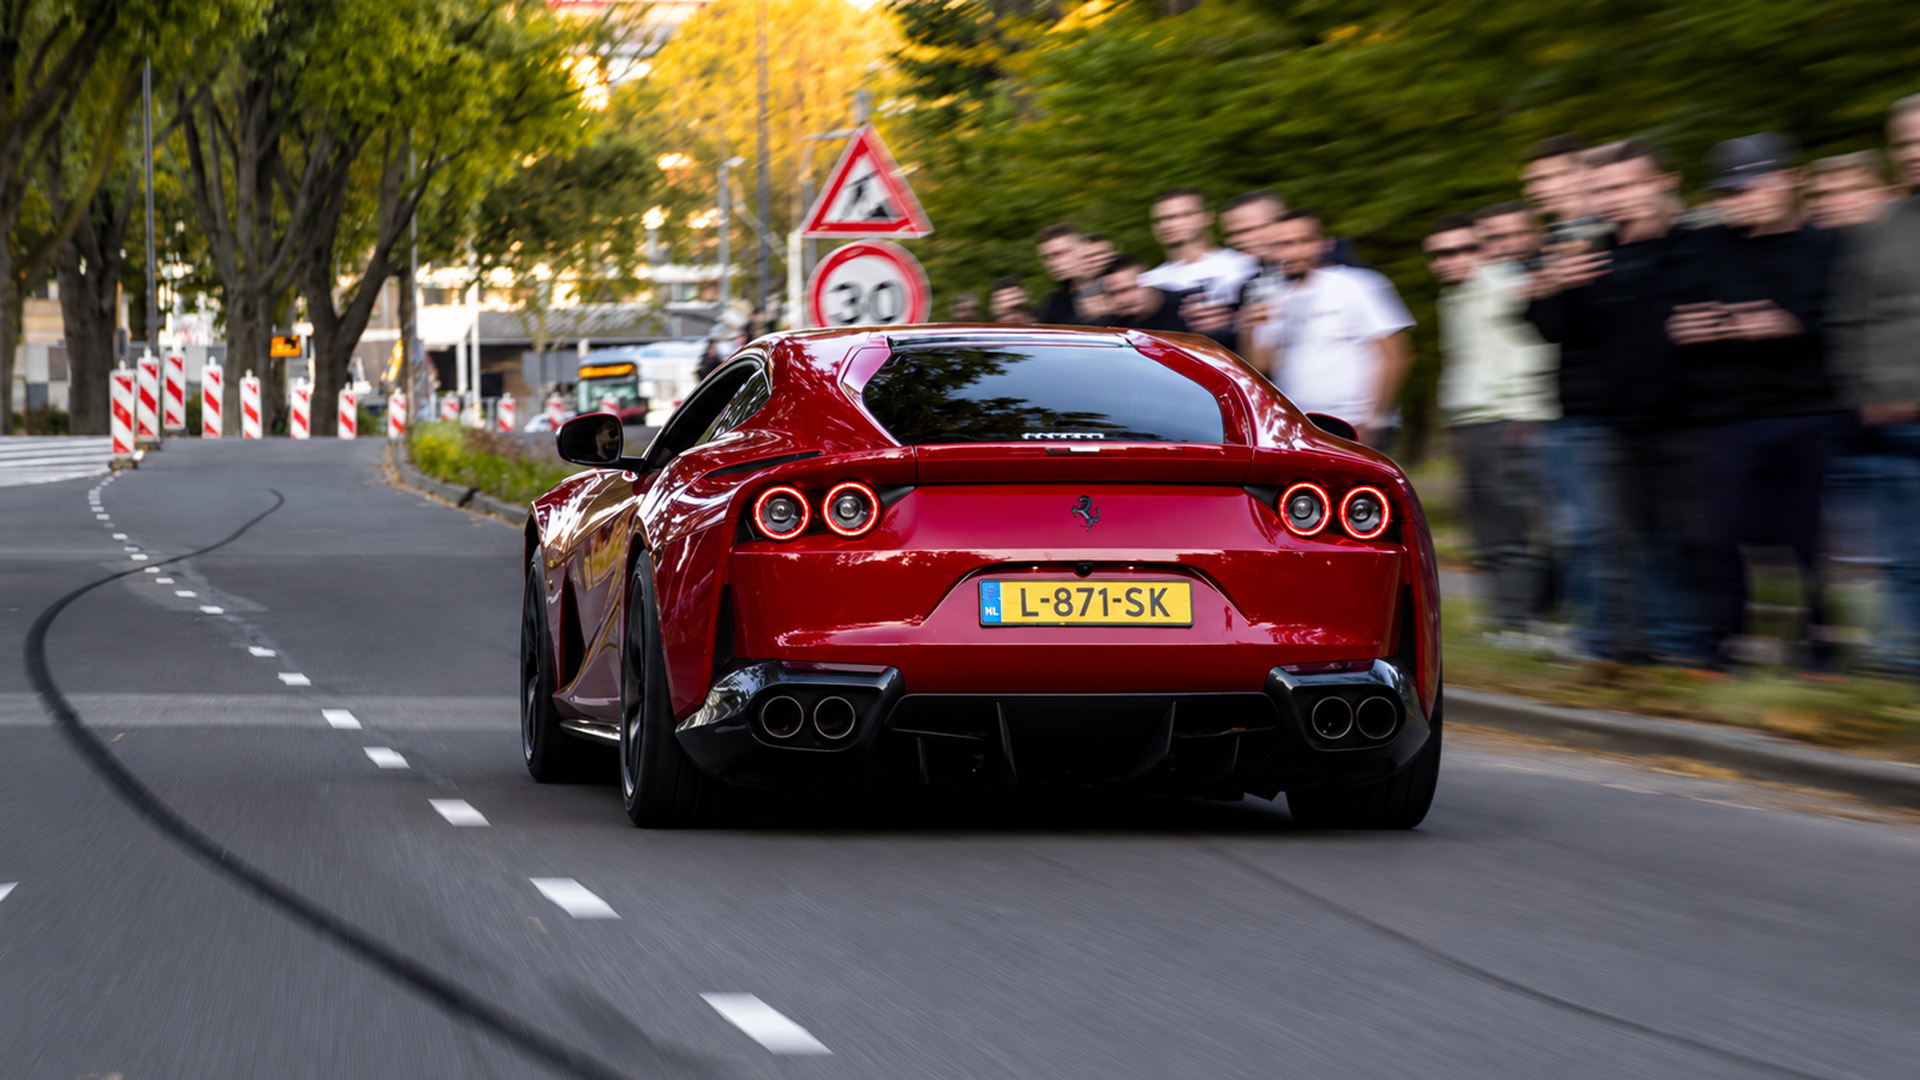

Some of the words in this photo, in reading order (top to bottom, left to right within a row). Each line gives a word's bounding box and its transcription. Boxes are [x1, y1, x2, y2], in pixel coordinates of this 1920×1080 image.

[829, 280, 904, 324] 30
[985, 606, 999, 617] NL
[1020, 587, 1170, 618] L-871-SK
